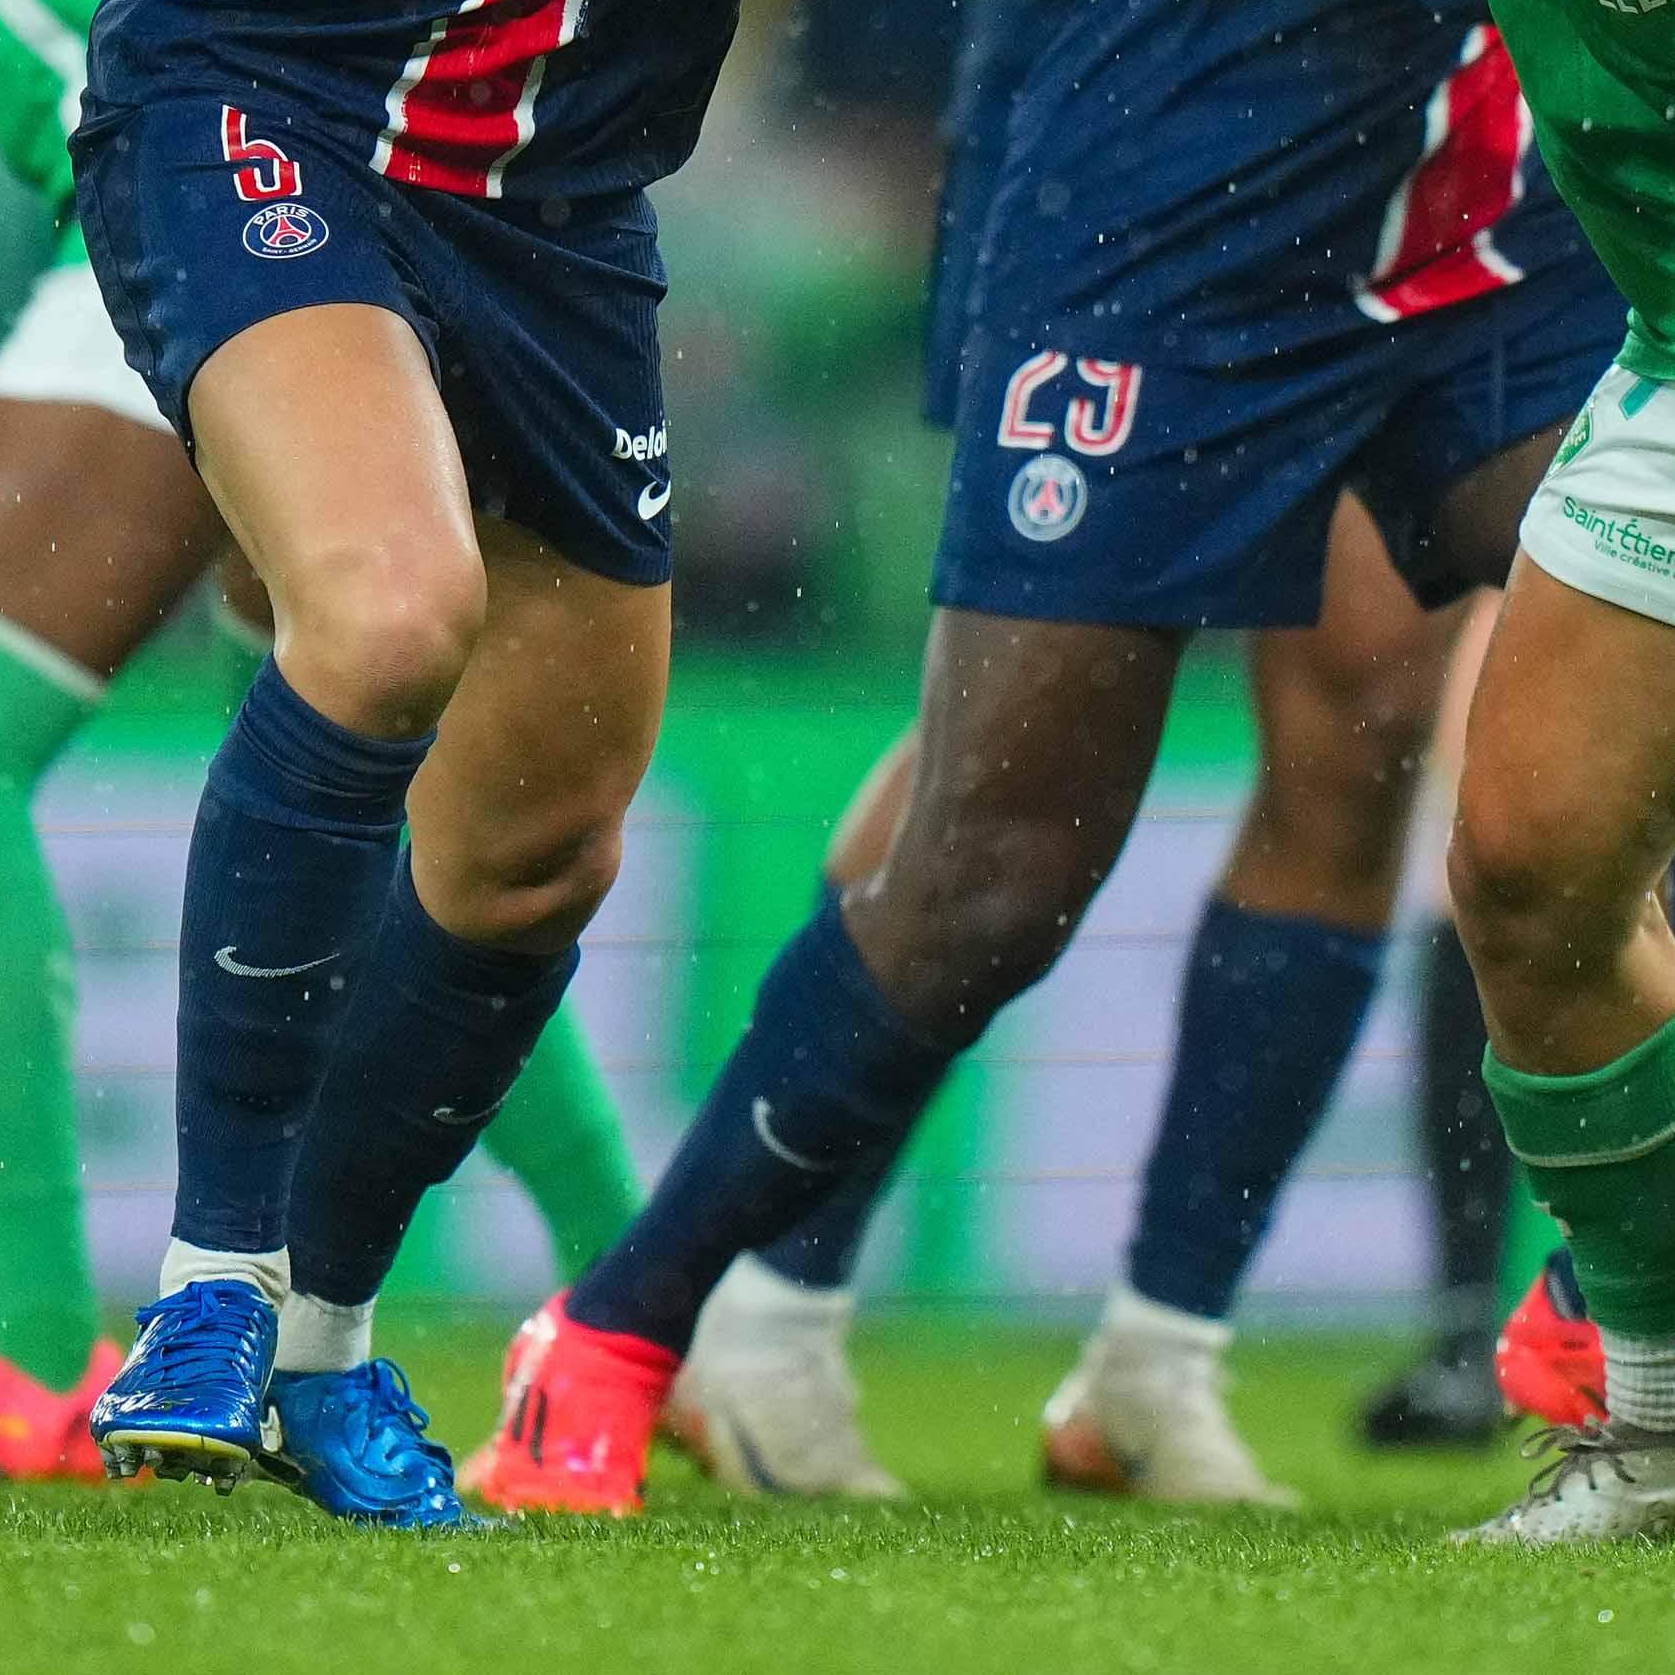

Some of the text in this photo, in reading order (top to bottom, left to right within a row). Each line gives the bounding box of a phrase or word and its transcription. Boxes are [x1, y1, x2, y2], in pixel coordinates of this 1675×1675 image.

[221, 104, 303, 202] 5
[253, 205, 309, 226] PARIS
[612, 419, 668, 462] Deloi
